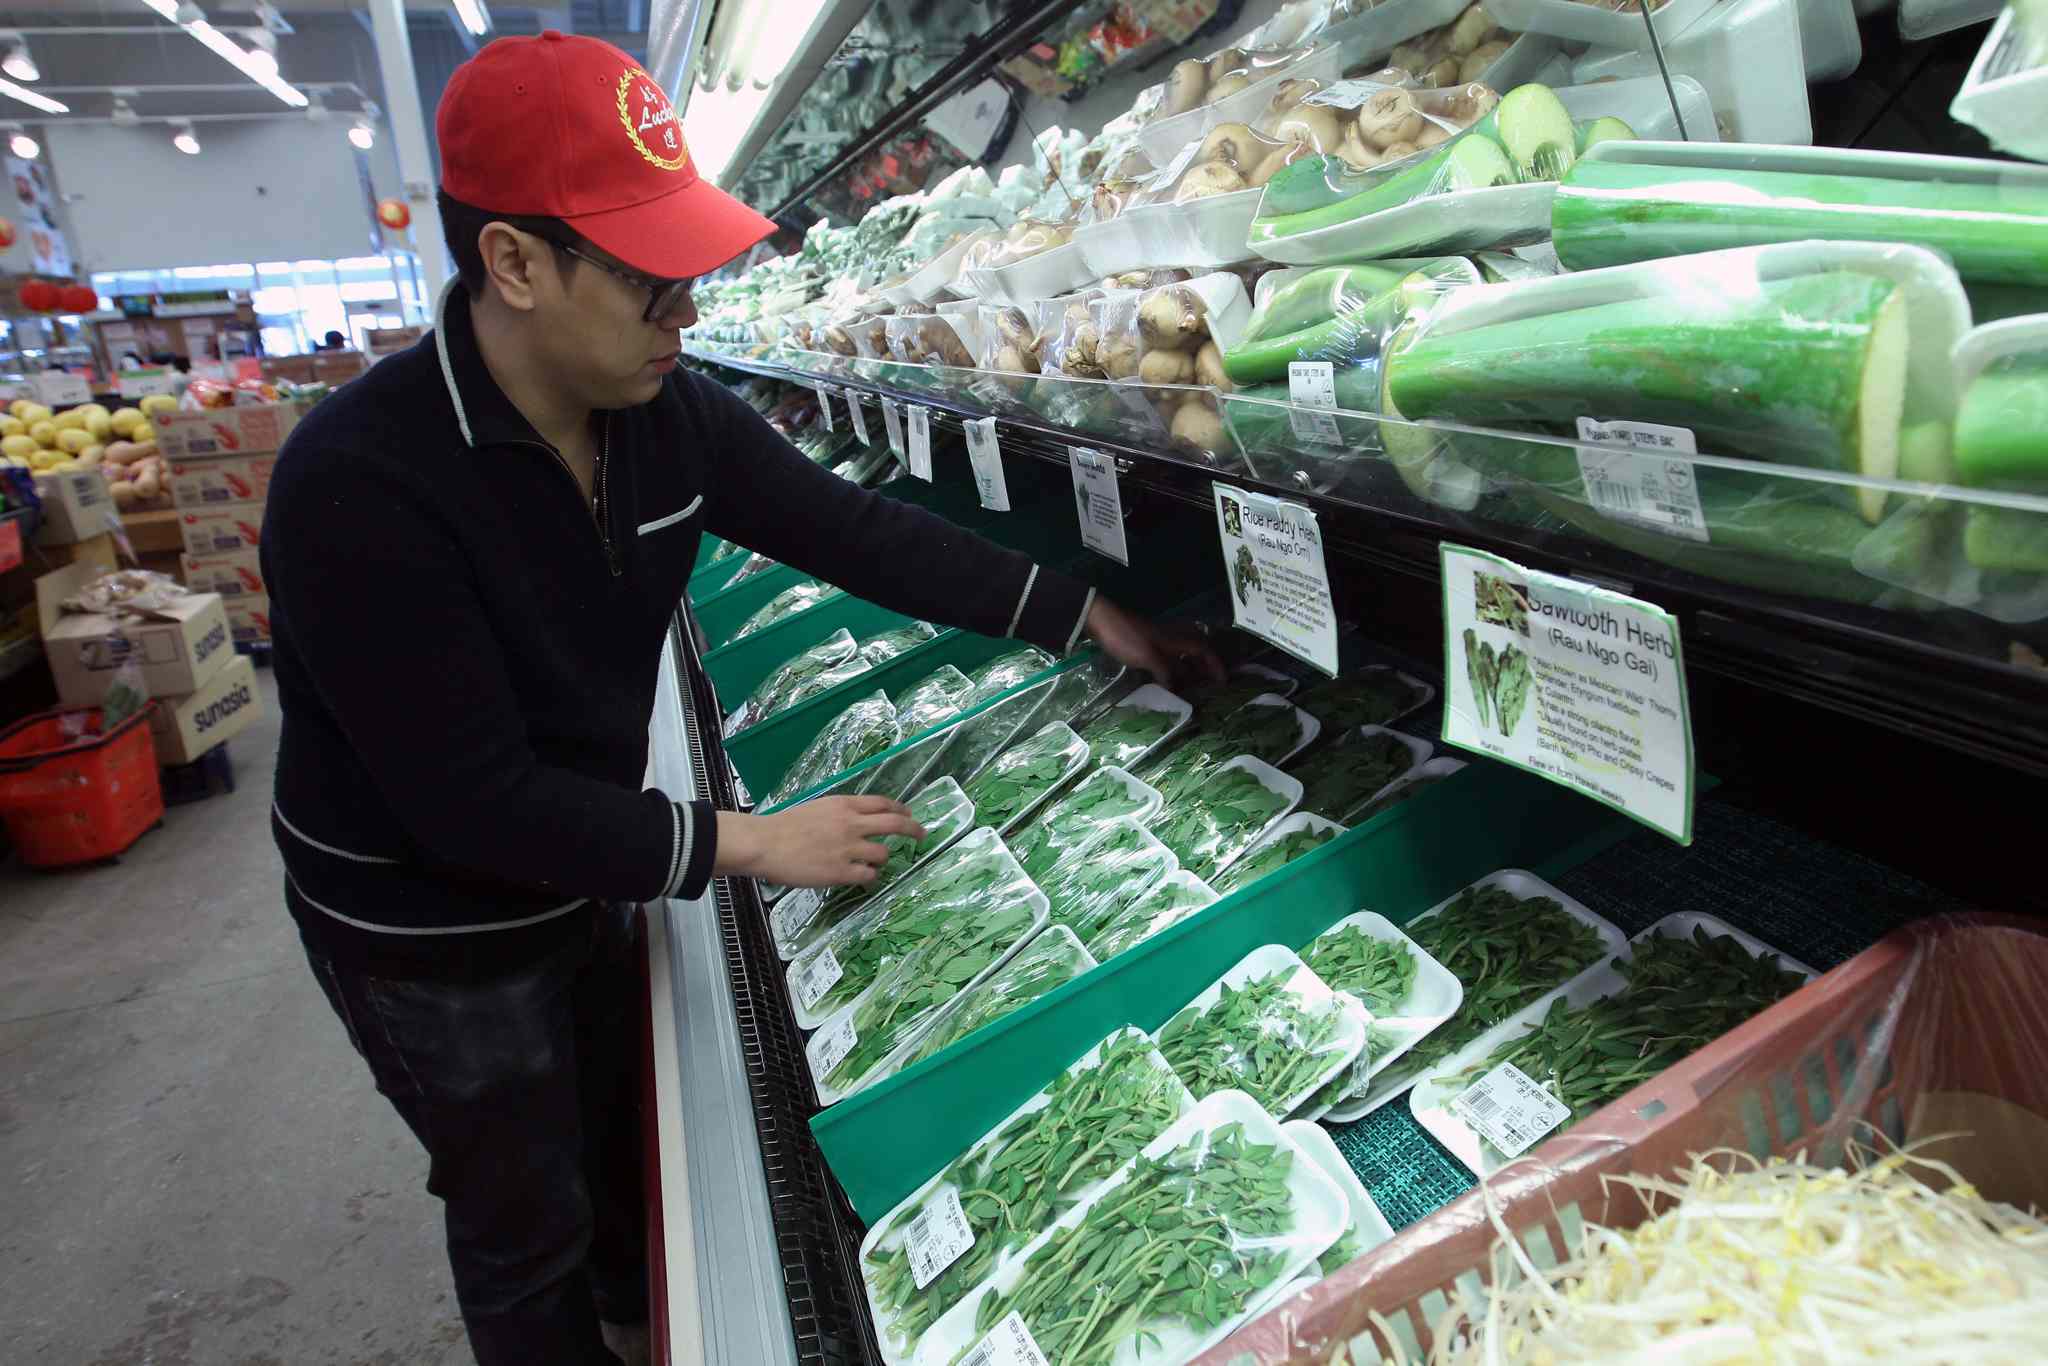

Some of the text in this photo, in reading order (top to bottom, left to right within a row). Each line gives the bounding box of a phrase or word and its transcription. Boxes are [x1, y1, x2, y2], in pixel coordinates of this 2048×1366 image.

[1277, 537, 1293, 556] Ngo
[1547, 626, 1658, 682] (Rau Ngo Gai)
[1626, 618, 1674, 659] Herb
